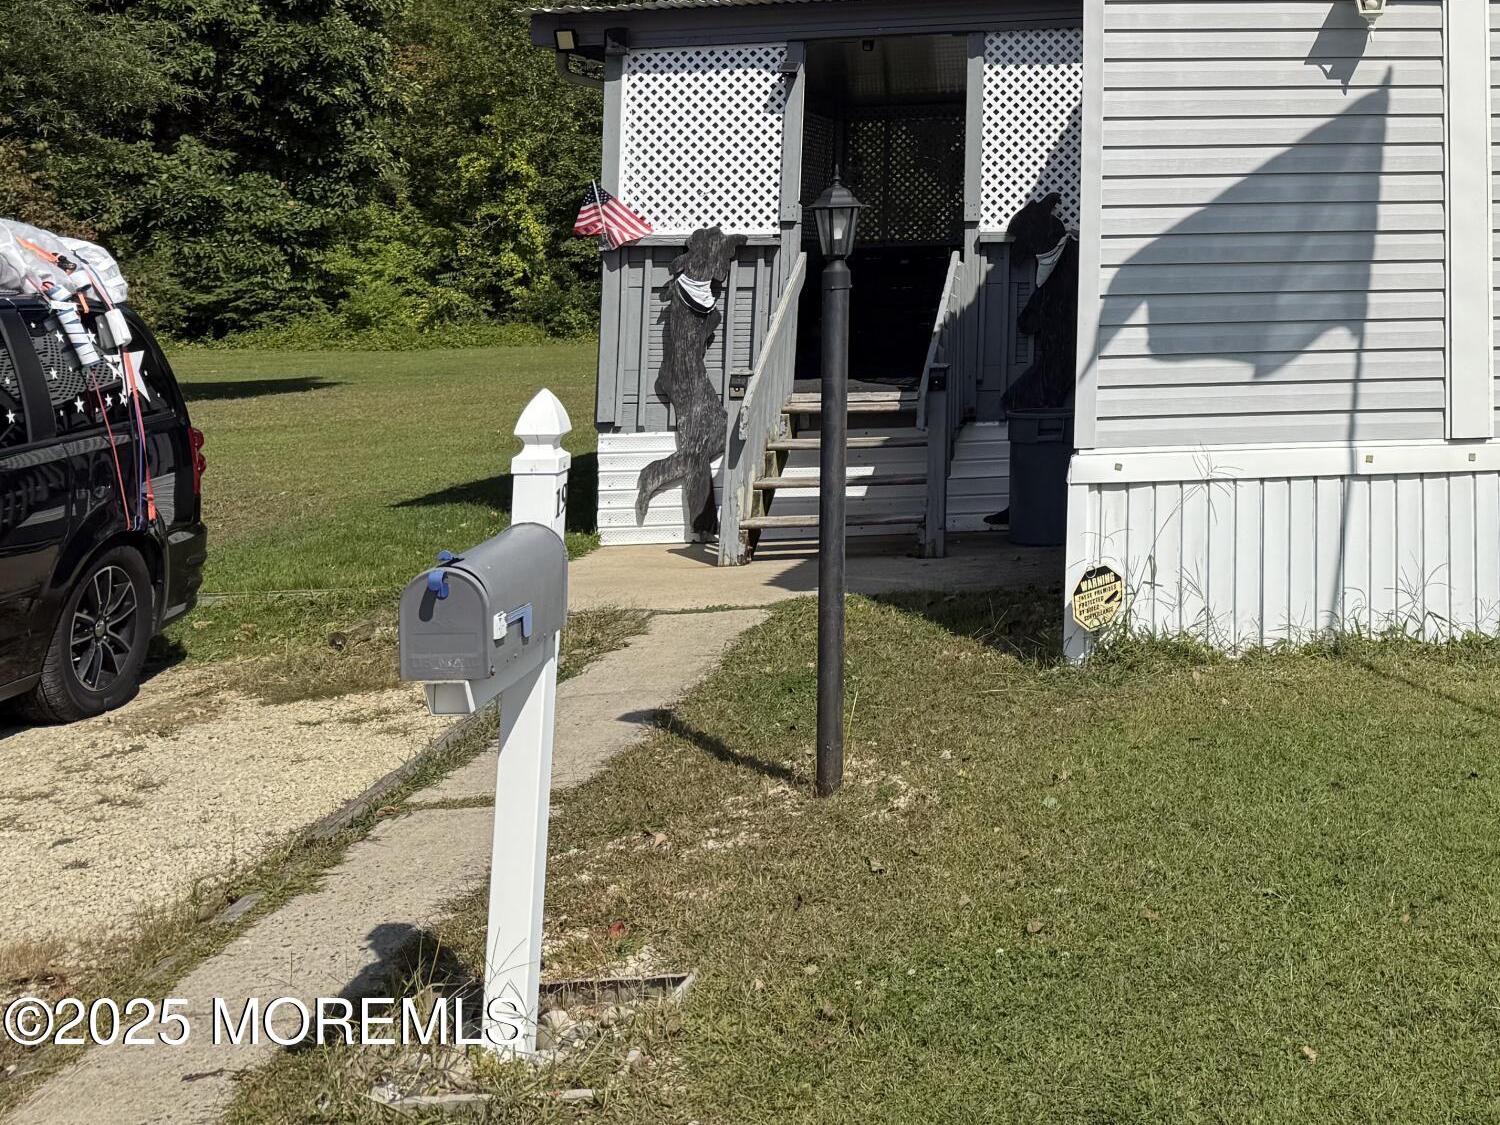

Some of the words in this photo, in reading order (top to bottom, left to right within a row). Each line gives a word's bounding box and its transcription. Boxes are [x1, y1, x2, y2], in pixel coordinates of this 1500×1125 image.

[1080, 572, 1115, 592] WARNING
[1094, 584, 1116, 596] PREMISES
[1079, 595, 1104, 609] PROTECTED
